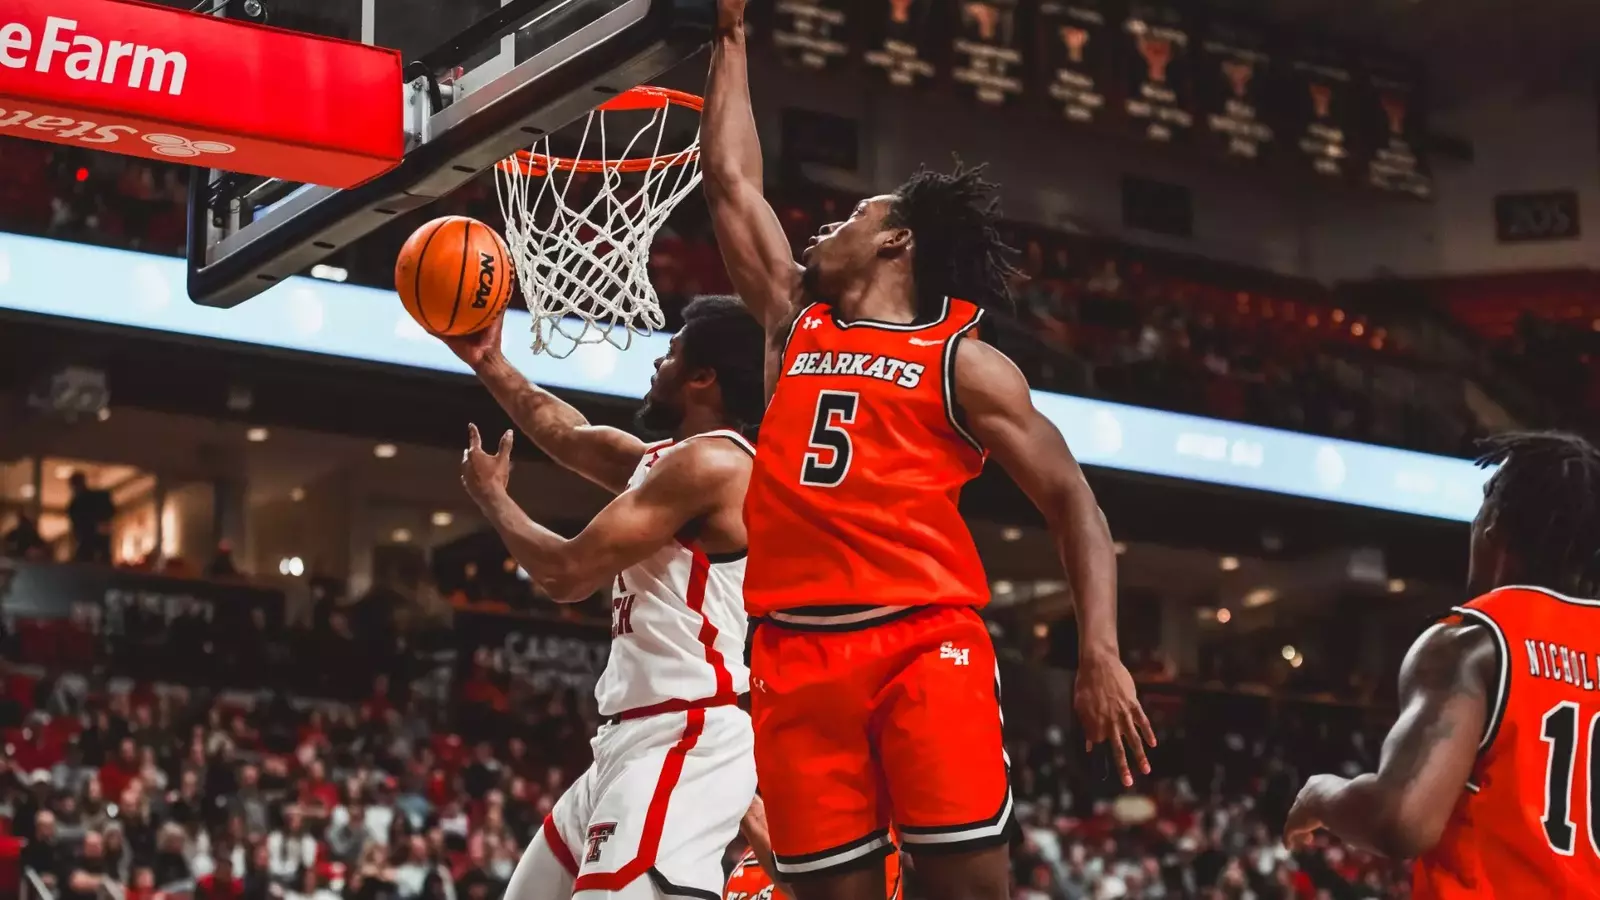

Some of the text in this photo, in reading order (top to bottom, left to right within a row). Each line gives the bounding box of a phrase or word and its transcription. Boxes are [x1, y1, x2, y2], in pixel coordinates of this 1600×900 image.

[0, 106, 138, 143] Stat
[472, 252, 495, 309] NCAA
[786, 351, 926, 389] BEARKATS
[800, 389, 860, 488] 5
